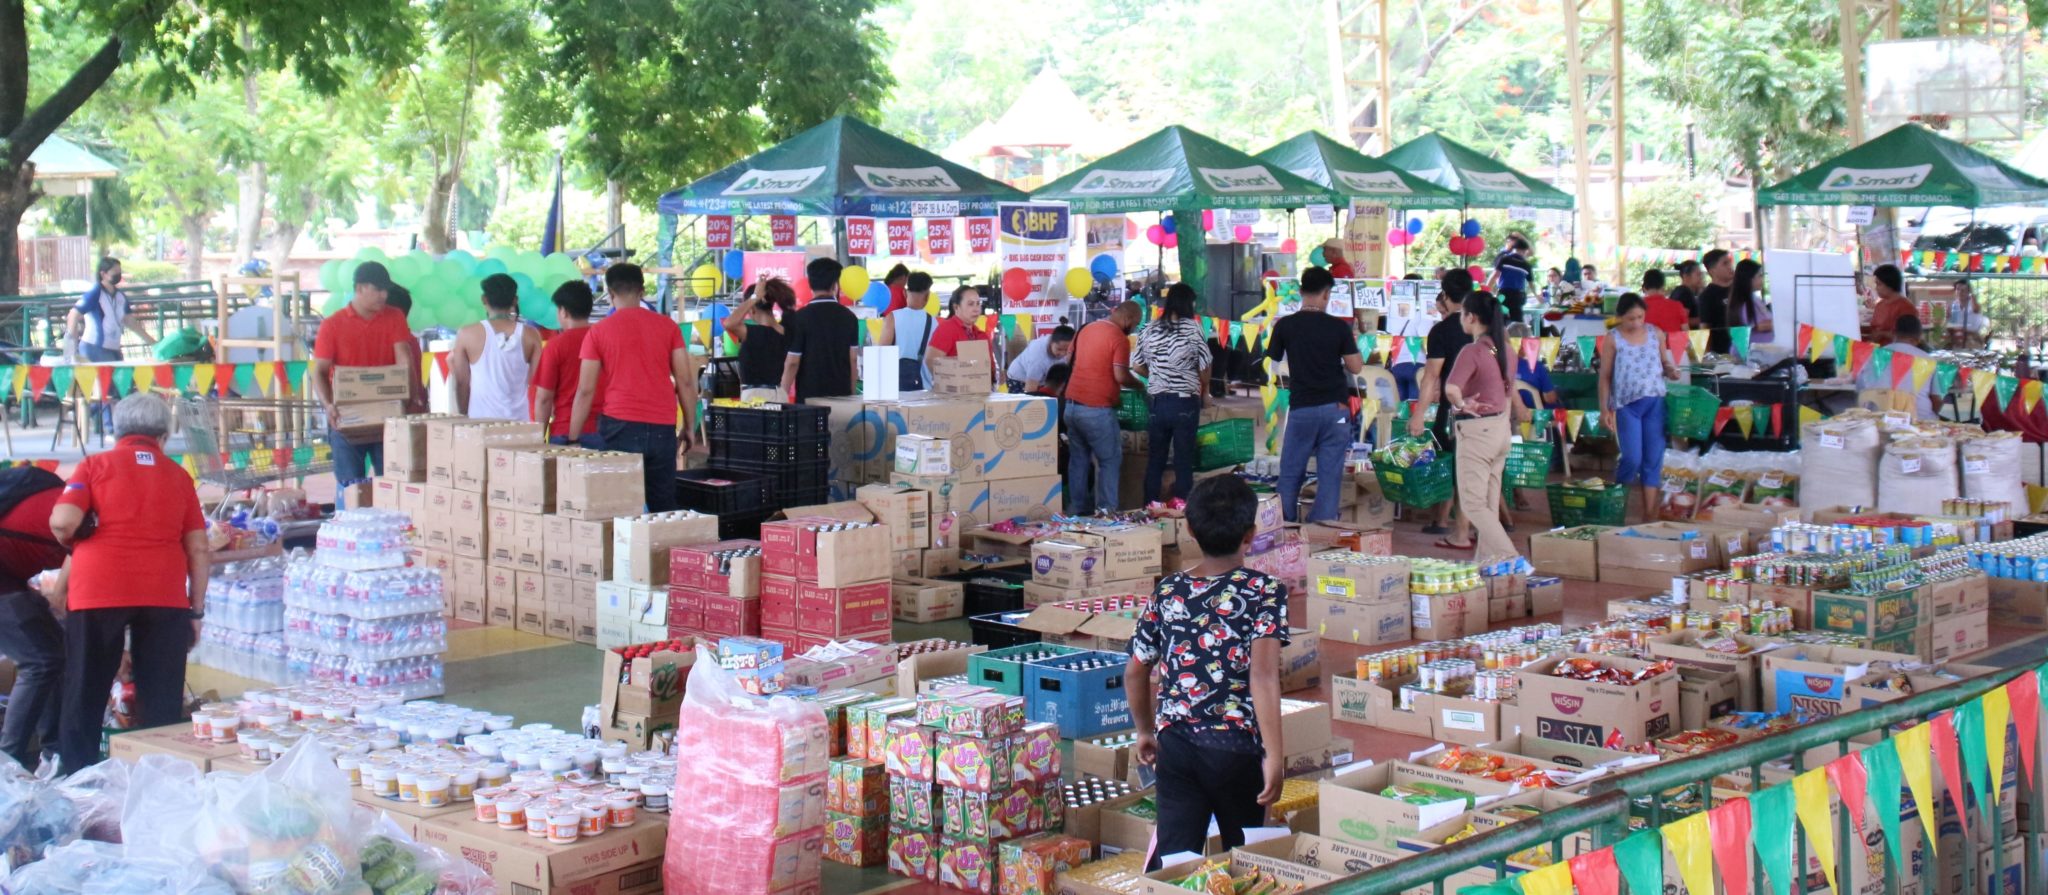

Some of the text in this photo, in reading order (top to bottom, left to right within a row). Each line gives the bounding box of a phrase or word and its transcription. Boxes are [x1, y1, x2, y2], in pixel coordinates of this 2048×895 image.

[755, 176, 810, 190] Smart
[888, 175, 951, 188] Smart
[1104, 177, 1161, 189] Smart
[1855, 173, 1919, 186] Smart
[708, 220, 730, 231] 20%
[772, 219, 794, 230] 25%
[1028, 212, 1059, 232] BHF
[849, 225, 872, 236] 15%
[889, 226, 912, 237] 20%
[929, 225, 951, 236] 25%
[970, 224, 991, 235] 15%
[708, 234, 728, 242] OFF
[773, 233, 792, 242] OFF
[971, 238, 989, 247] OFF
[850, 239, 870, 249] OFF
[890, 240, 910, 250] OFF
[930, 239, 949, 249] OFF
[755, 267, 788, 275] HOME
[1357, 288, 1386, 307] BUY 1
[1359, 298, 1379, 307] TAKE
[1448, 597, 1467, 610] STAR
[1878, 599, 1900, 617] MEGA
[652, 668, 679, 698] C2
[1807, 678, 1832, 689] NISSIN
[1554, 696, 1581, 709] NISSIN
[1647, 717, 1669, 734] PASTA
[1540, 720, 1600, 748] PASTA
[1397, 765, 1464, 785] HANDLE WITH CARE
[583, 845, 629, 865] THIS SIDE UP
[1331, 843, 1349, 856] CARE
[1350, 848, 1368, 859] WITH
[1277, 868, 1305, 882] HANDLE
